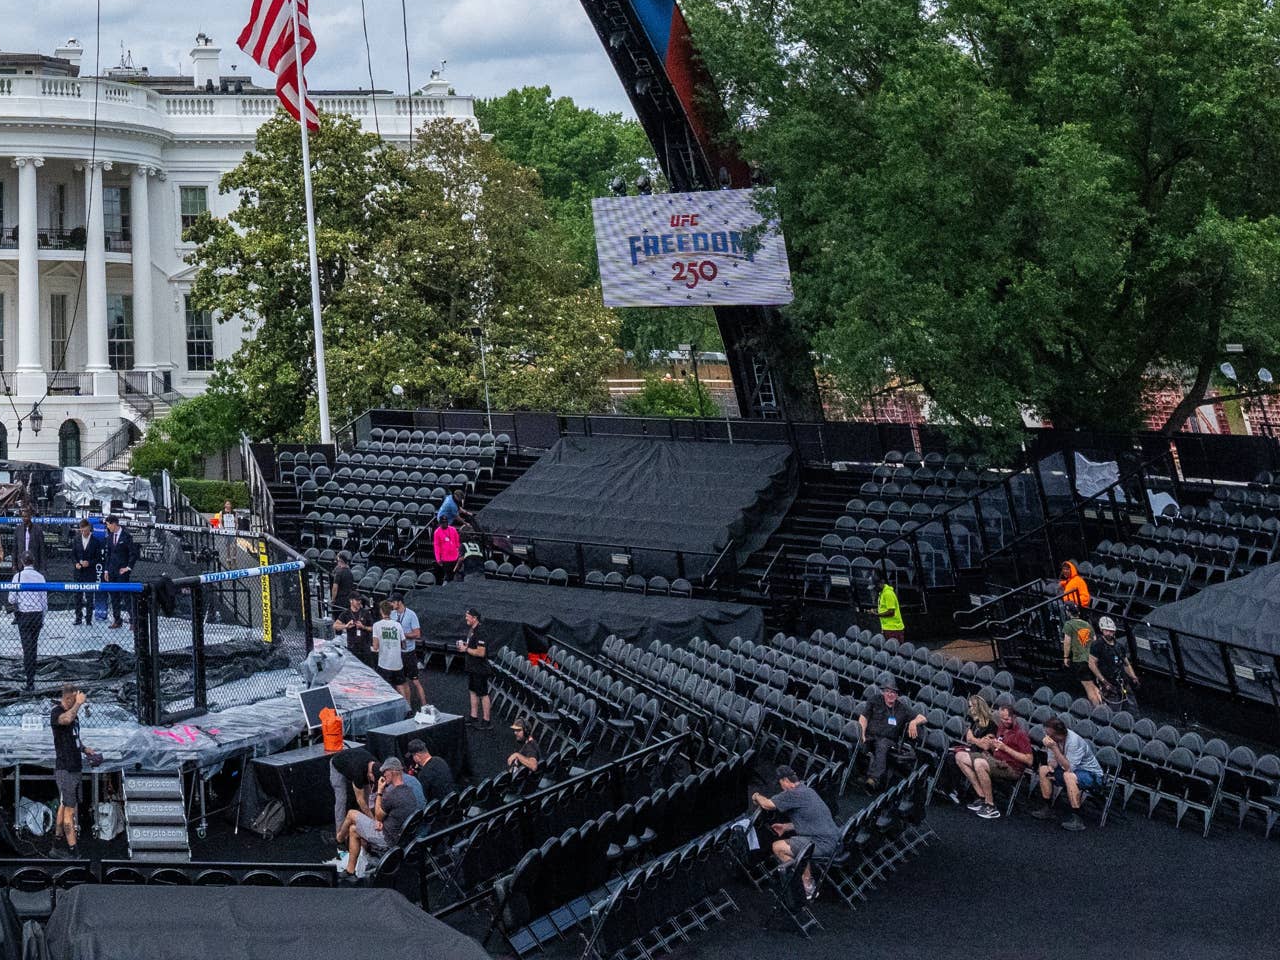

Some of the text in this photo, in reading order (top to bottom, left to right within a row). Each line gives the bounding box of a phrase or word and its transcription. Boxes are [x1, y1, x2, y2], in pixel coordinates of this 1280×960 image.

[670, 213, 700, 227] UFC
[671, 260, 718, 289] 250
[258, 561, 300, 574] TOYO TIRES
[205, 567, 249, 582] TOYO TIRES
[1, 582, 21, 590] LIGHT
[137, 780, 177, 788] crypto.com
[140, 804, 180, 813] crypto.com
[142, 829, 183, 838] crypto.com
